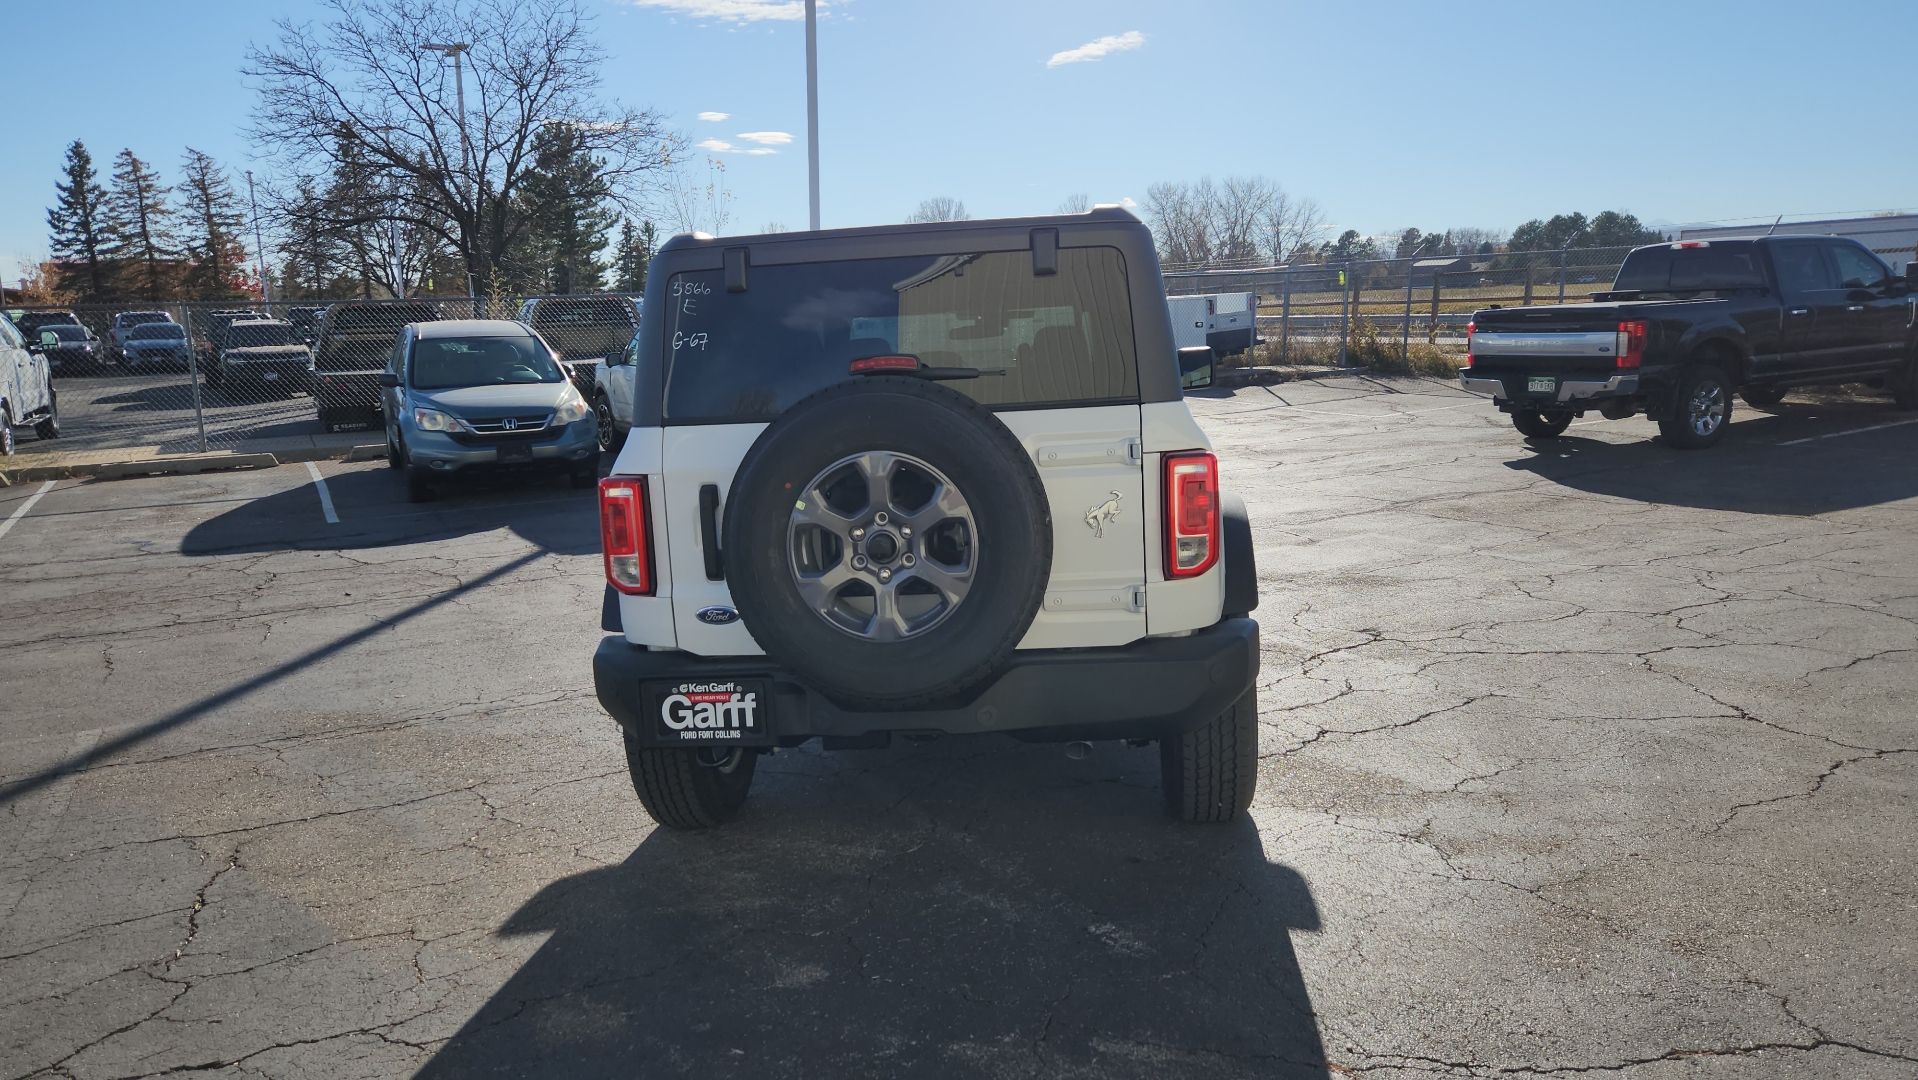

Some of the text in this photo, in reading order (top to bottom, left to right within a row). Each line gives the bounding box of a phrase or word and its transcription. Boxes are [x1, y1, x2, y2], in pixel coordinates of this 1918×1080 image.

[683, 299, 697, 315] E
[672, 331, 709, 350] G-67
[706, 610, 730, 621] Ford
[689, 682, 735, 693] Ken Garff
[661, 693, 757, 730] Garff
[680, 730, 741, 739] FORD FORT COLLINS
